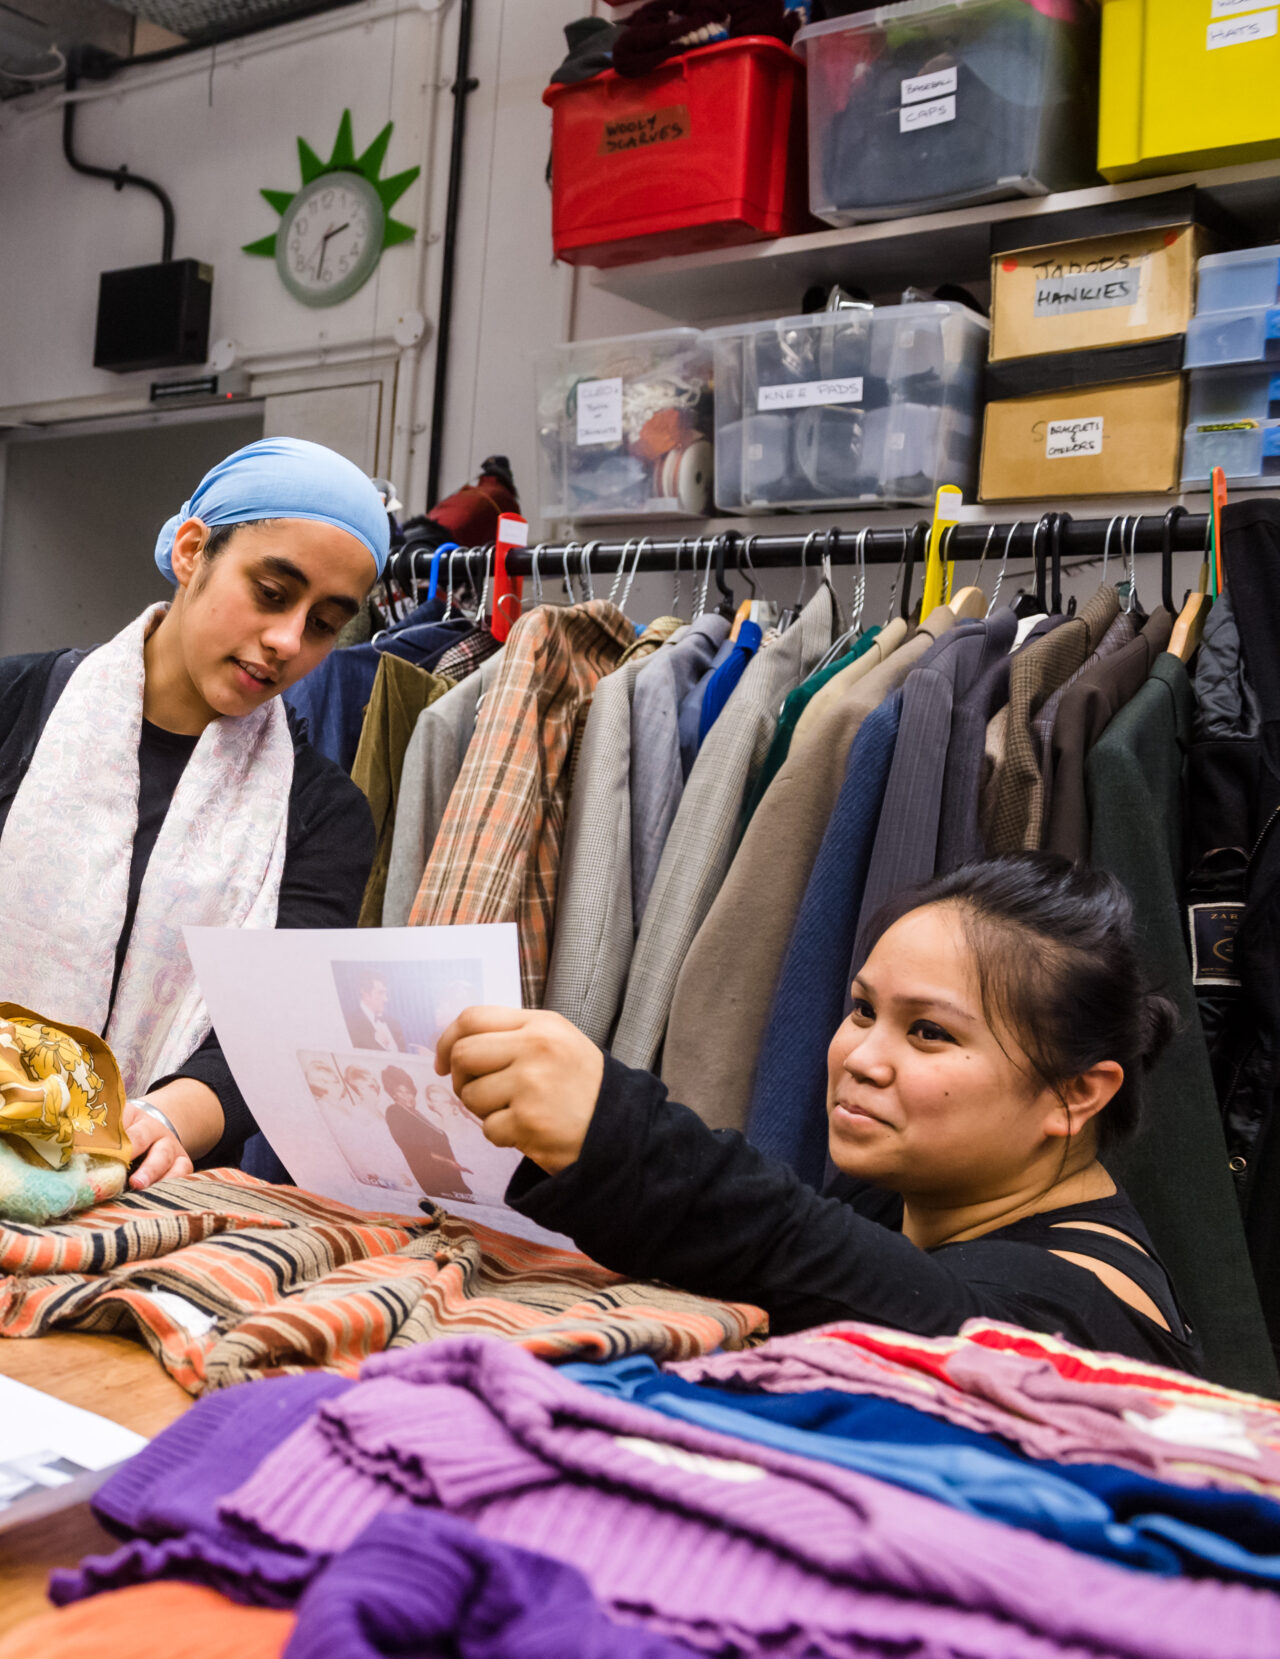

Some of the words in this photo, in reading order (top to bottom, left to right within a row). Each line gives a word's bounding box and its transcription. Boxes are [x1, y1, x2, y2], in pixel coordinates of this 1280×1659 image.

[1210, 22, 1261, 41] HATS
[905, 105, 949, 122] CAPS
[1037, 280, 1131, 306] HANKIES
[764, 387, 808, 401] KNEE
[816, 383, 860, 395] PADS
